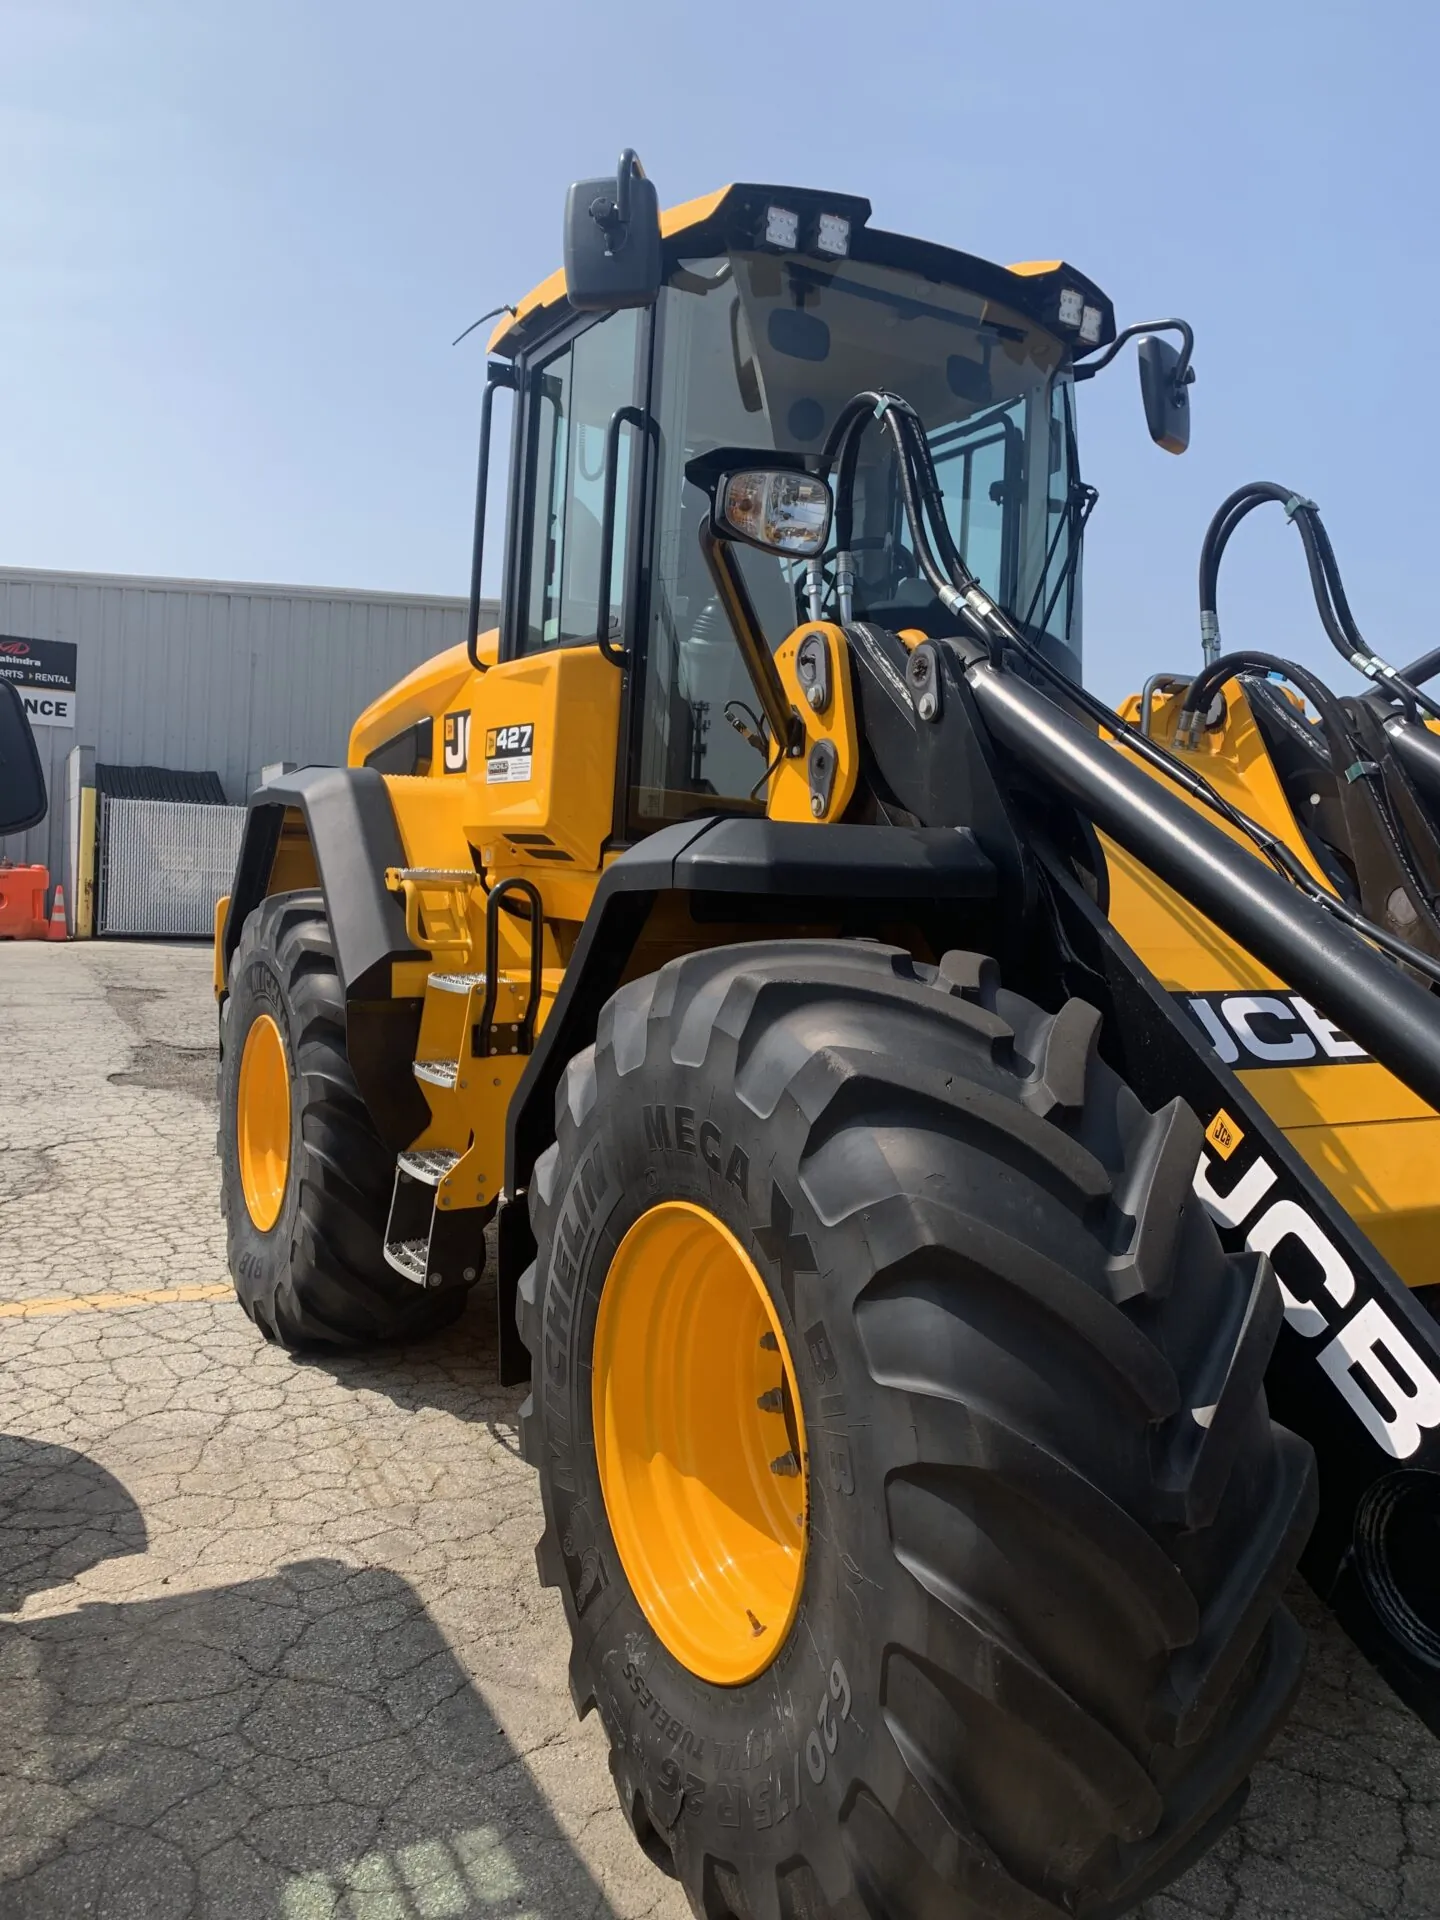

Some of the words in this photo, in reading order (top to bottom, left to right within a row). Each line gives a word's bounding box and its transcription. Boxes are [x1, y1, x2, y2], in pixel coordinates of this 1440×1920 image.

[35, 672, 71, 684] RENTAL
[496, 725, 532, 750] 427
[1215, 1122, 1232, 1146] JCB
[1191, 1150, 1440, 1460] JCB
[621, 1661, 706, 1760] TUBELESS
